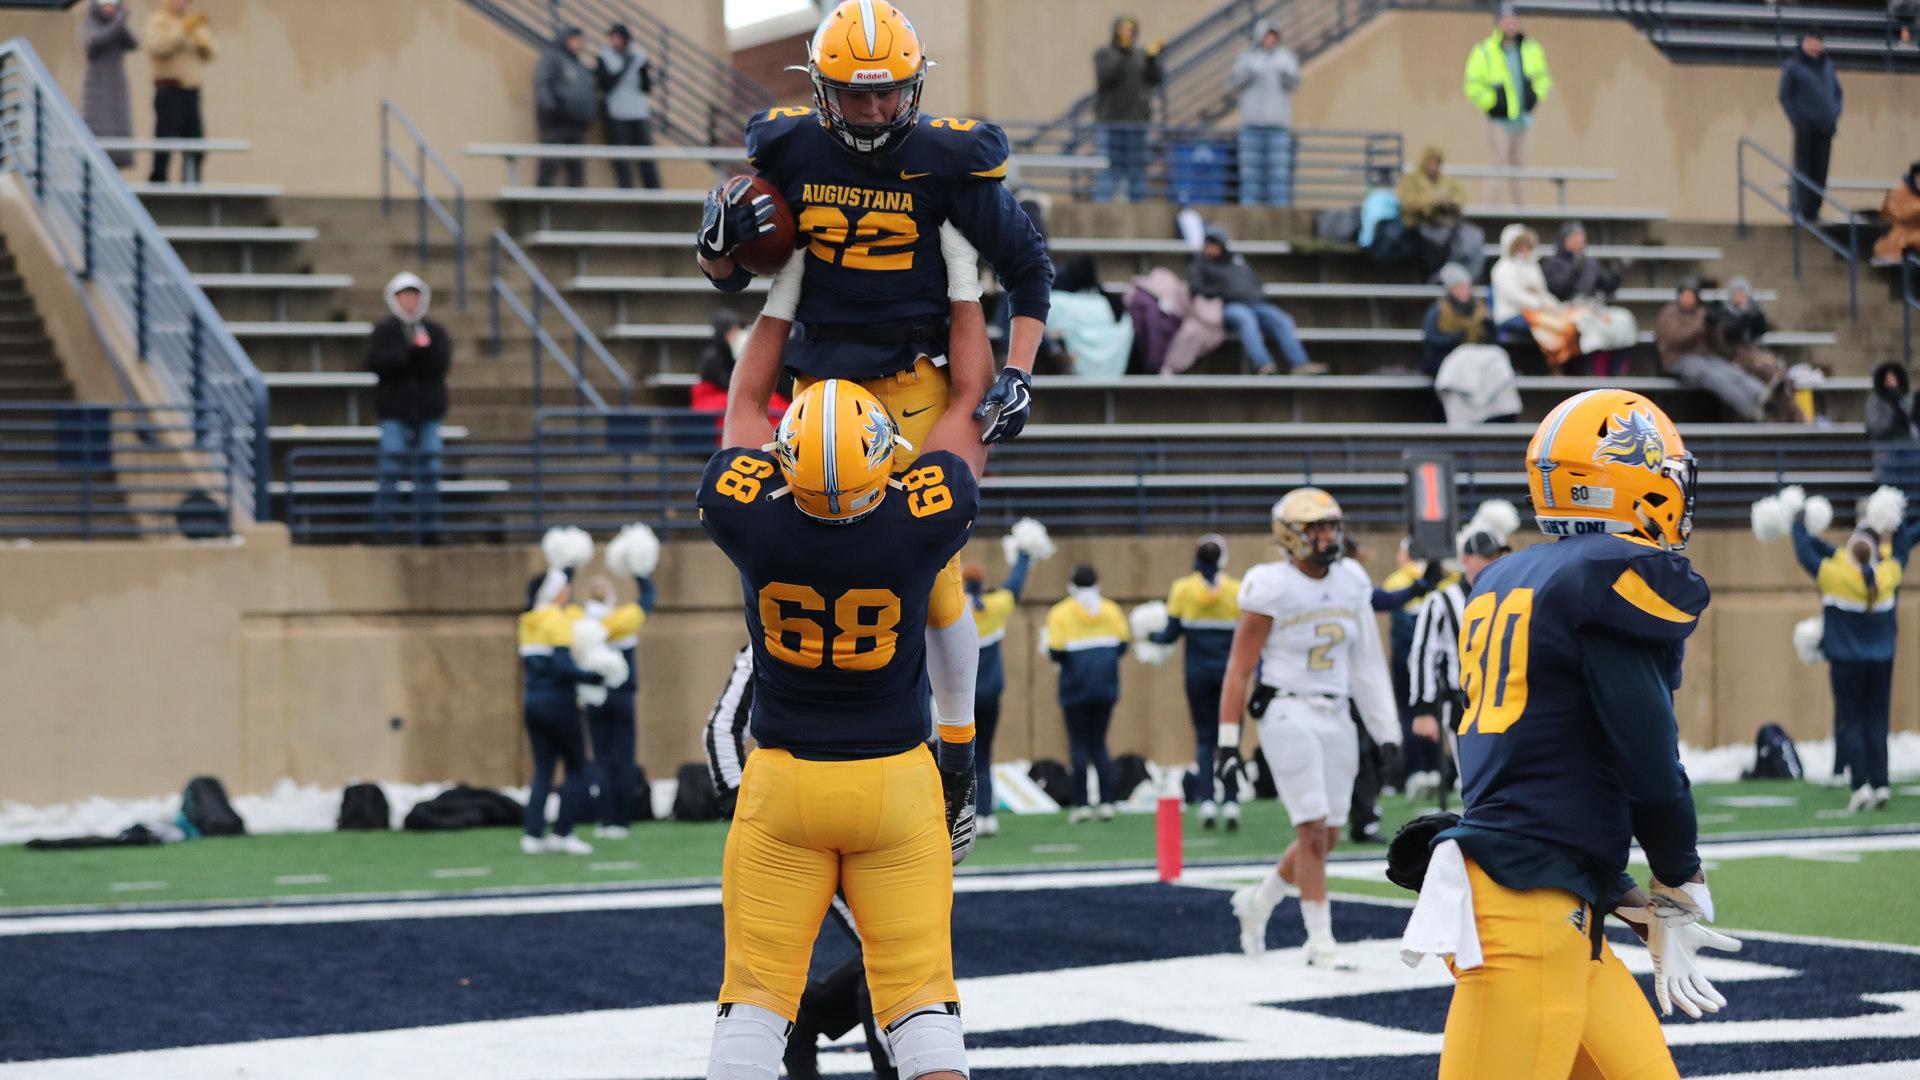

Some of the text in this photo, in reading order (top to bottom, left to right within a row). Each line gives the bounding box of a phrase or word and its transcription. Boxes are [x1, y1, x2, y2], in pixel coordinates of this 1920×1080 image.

[857, 72, 888, 80] Riddell
[802, 184, 914, 212] AUGUSTANA
[798, 206, 920, 271] 22
[1571, 486, 1589, 501] 80
[1541, 520, 1606, 534] GHT ON!
[758, 581, 901, 671] 68
[1307, 623, 1345, 671] 2
[1457, 588, 1534, 735] 80
